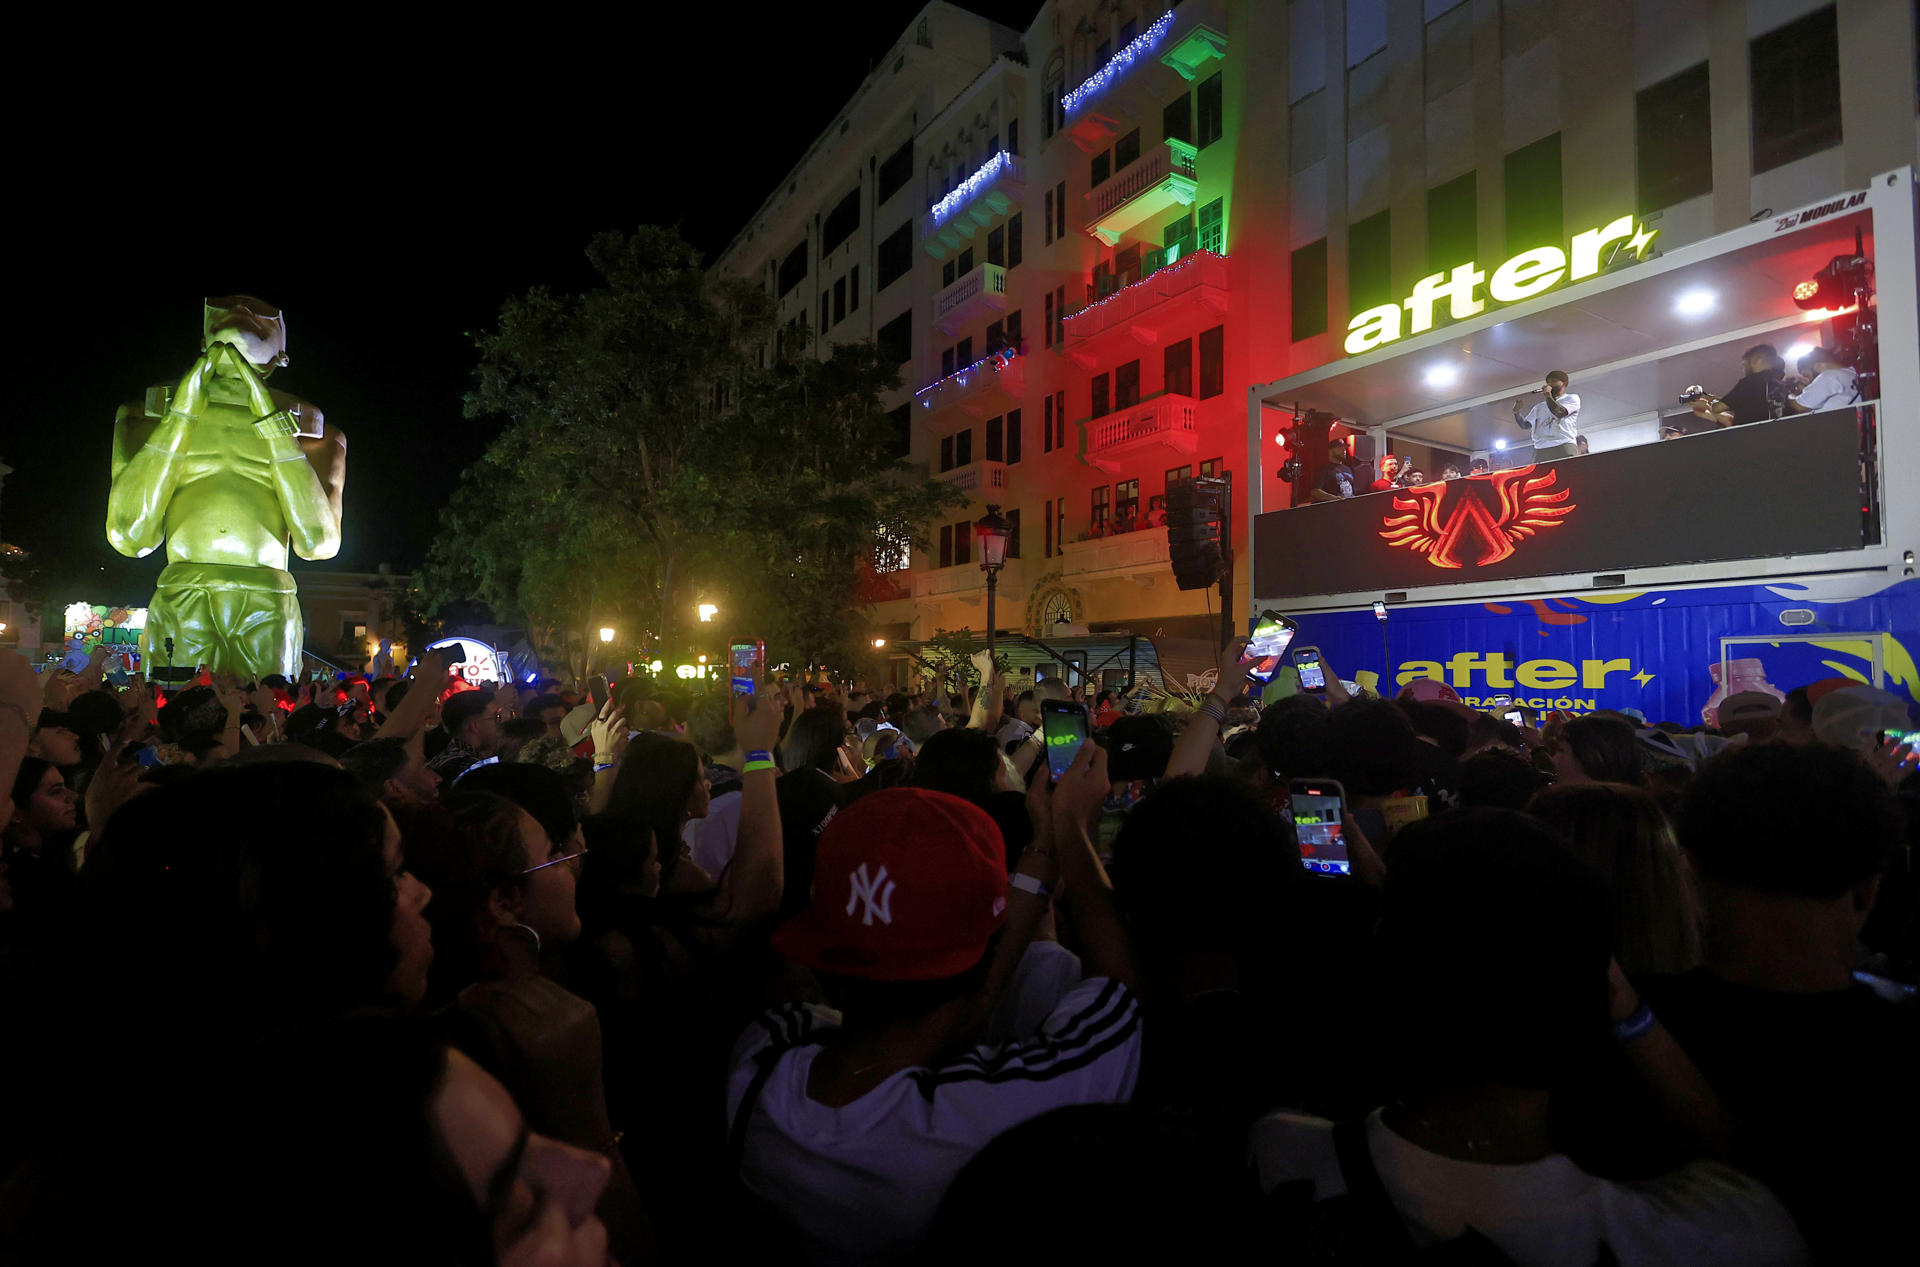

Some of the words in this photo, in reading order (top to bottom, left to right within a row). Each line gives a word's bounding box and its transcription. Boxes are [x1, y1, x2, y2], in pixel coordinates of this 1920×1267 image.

[1799, 191, 1867, 224] MODULAR
[1344, 214, 1634, 355] after
[1395, 652, 1631, 690] after
[1458, 696, 1596, 710] RAACIÓN
[847, 863, 896, 927] NY
